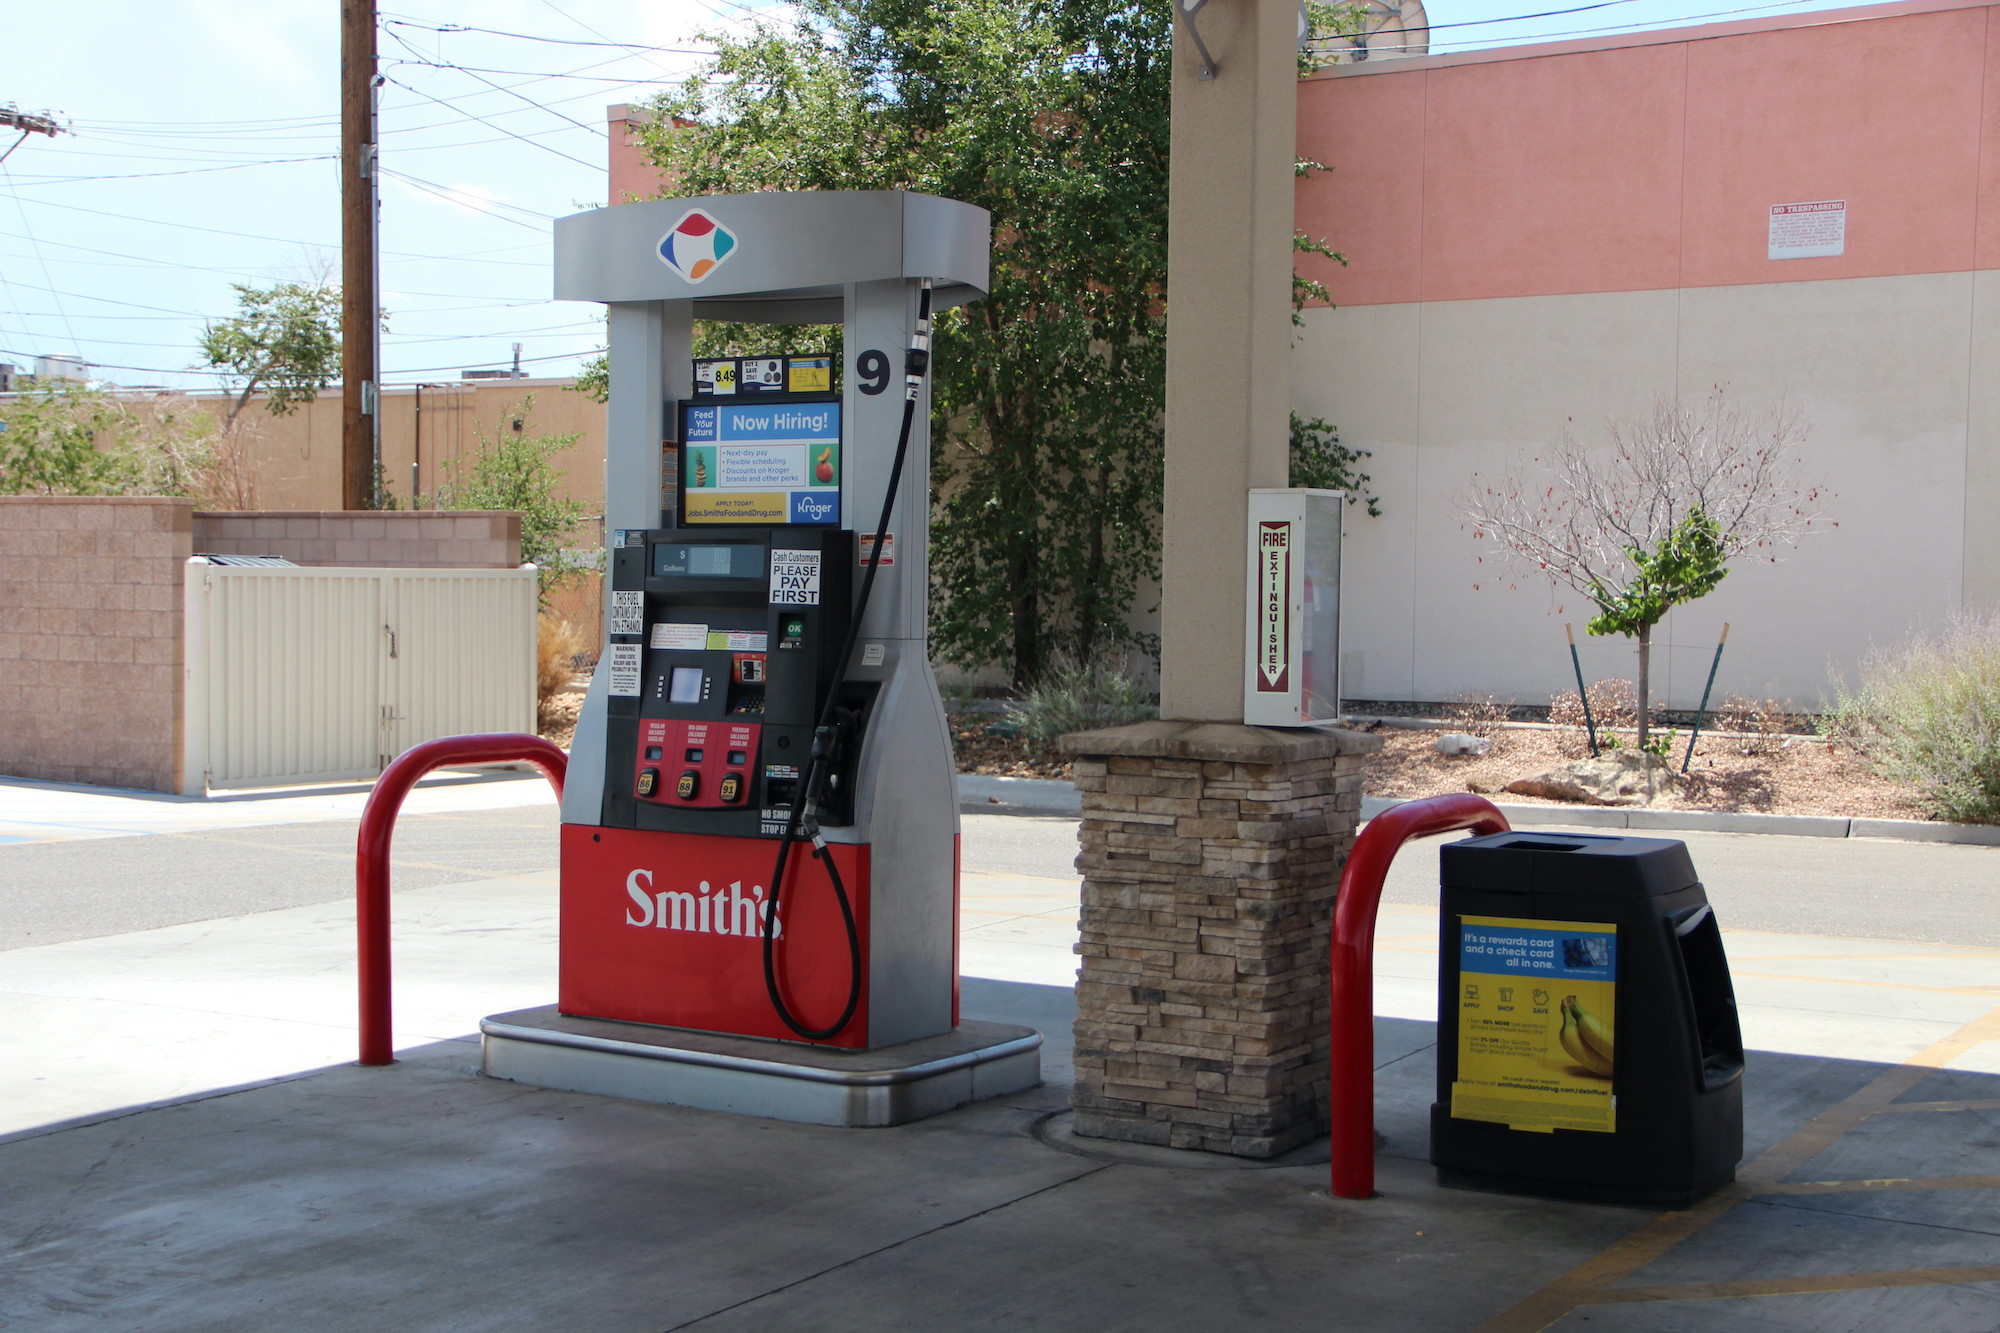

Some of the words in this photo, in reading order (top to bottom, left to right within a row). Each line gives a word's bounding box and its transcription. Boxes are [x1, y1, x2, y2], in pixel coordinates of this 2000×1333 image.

[1787, 203, 1843, 212] TRESPASSING
[716, 370, 736, 382] 8.49
[857, 350, 890, 395] 9
[695, 410, 713, 419] Feed
[696, 420, 713, 428] Your
[733, 415, 768, 431] Now
[774, 412, 828, 432] Hiring!
[689, 428, 713, 436] Future
[768, 467, 789, 475] Kroger
[688, 509, 782, 517] Jobs.SmithsFoodandDrug.com
[798, 497, 832, 520] Kroger
[1263, 533, 1286, 547] FIRE
[773, 552, 787, 562] Cash
[789, 552, 819, 563] Customers
[774, 566, 817, 576] PLEASE
[781, 577, 810, 589] PAY
[617, 592, 626, 605] THIS
[628, 592, 638, 605] FUEL
[773, 590, 818, 602] FIRST
[612, 606, 630, 619] CONTAINS
[631, 606, 636, 619] UP
[638, 606, 642, 619] TO
[1269, 551, 1278, 674] EXTINGUISHER
[622, 620, 641, 632] ETHANOL
[640, 780, 649, 788] 86
[680, 783, 690, 791] 88
[723, 786, 733, 794] 91
[762, 809, 771, 818] NO
[761, 824, 779, 834] STOP
[626, 868, 782, 939] Smith's
[1464, 933, 1477, 943] It's
[1489, 936, 1527, 946] rewards
[1530, 939, 1554, 948] card
[1465, 945, 1484, 954] and
[1496, 947, 1527, 956] check
[1530, 950, 1554, 958] card
[1506, 958, 1518, 967] all
[1522, 958, 1530, 967] in
[1533, 960, 1555, 969] one.
